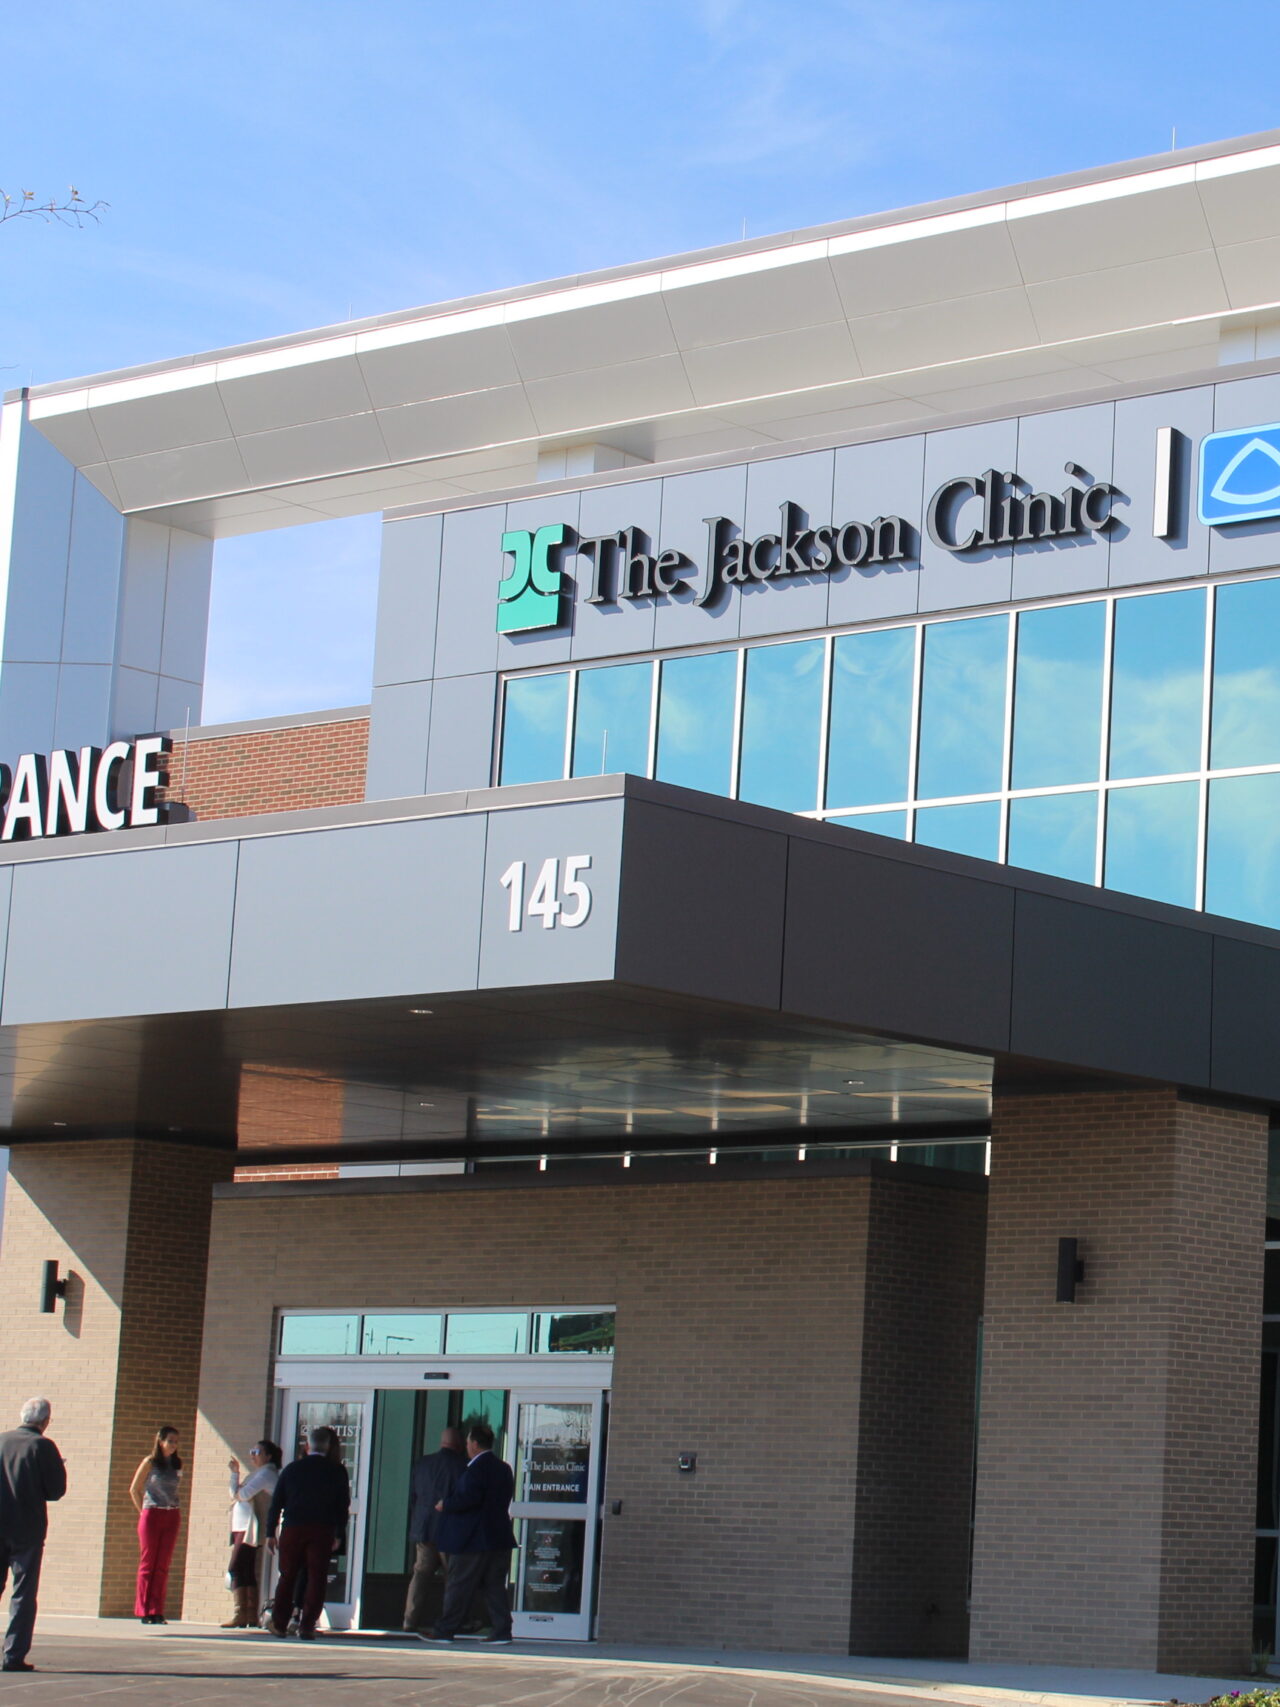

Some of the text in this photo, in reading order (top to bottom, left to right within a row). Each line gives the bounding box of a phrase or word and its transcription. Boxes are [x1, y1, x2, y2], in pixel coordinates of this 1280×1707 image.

[577, 460, 1115, 608] The Jackson Clinic
[0, 736, 165, 841] ANCE
[499, 854, 592, 932] 145
[542, 1483, 580, 1492] ENTRANCE
